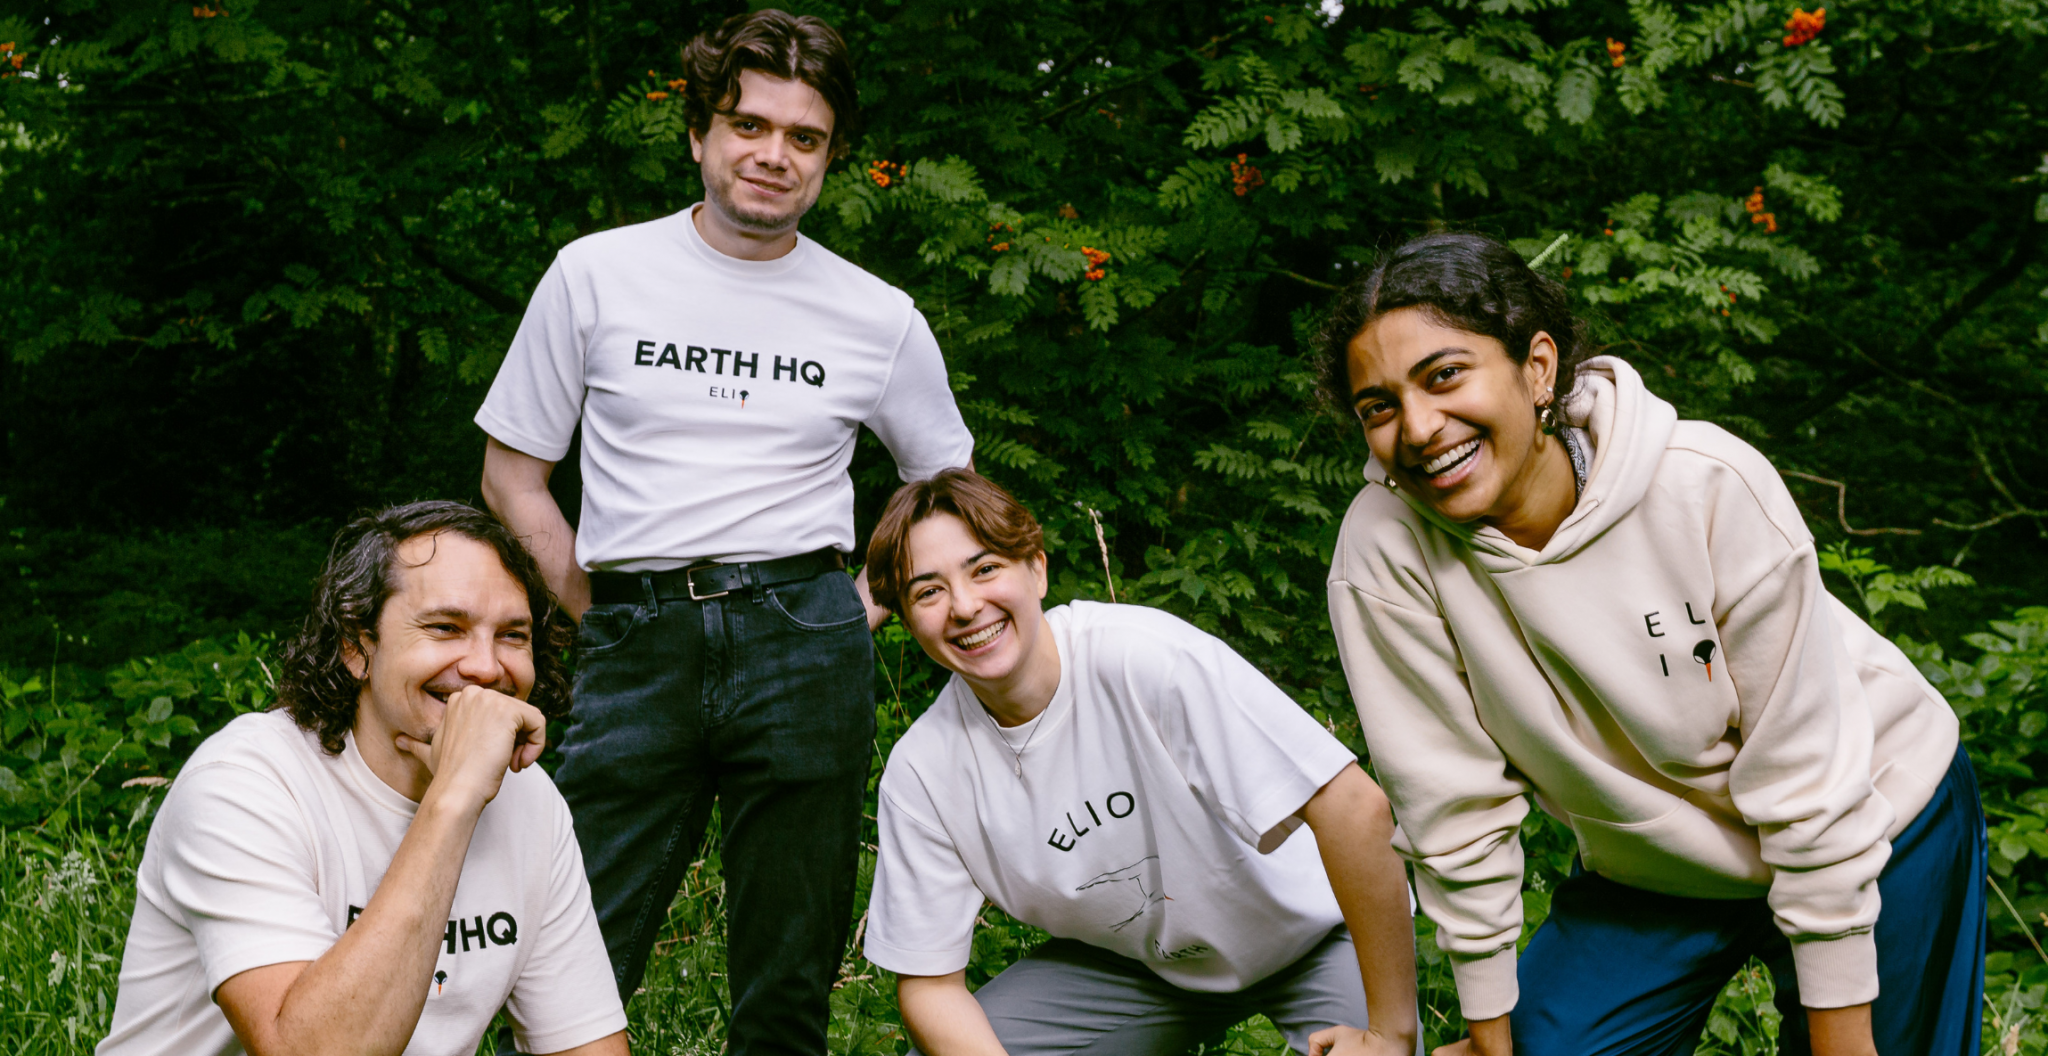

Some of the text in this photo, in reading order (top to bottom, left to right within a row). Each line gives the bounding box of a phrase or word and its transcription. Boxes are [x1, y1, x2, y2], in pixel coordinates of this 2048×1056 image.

[634, 339, 826, 388] EARTH HQ
[1047, 790, 1135, 852] ELIO
